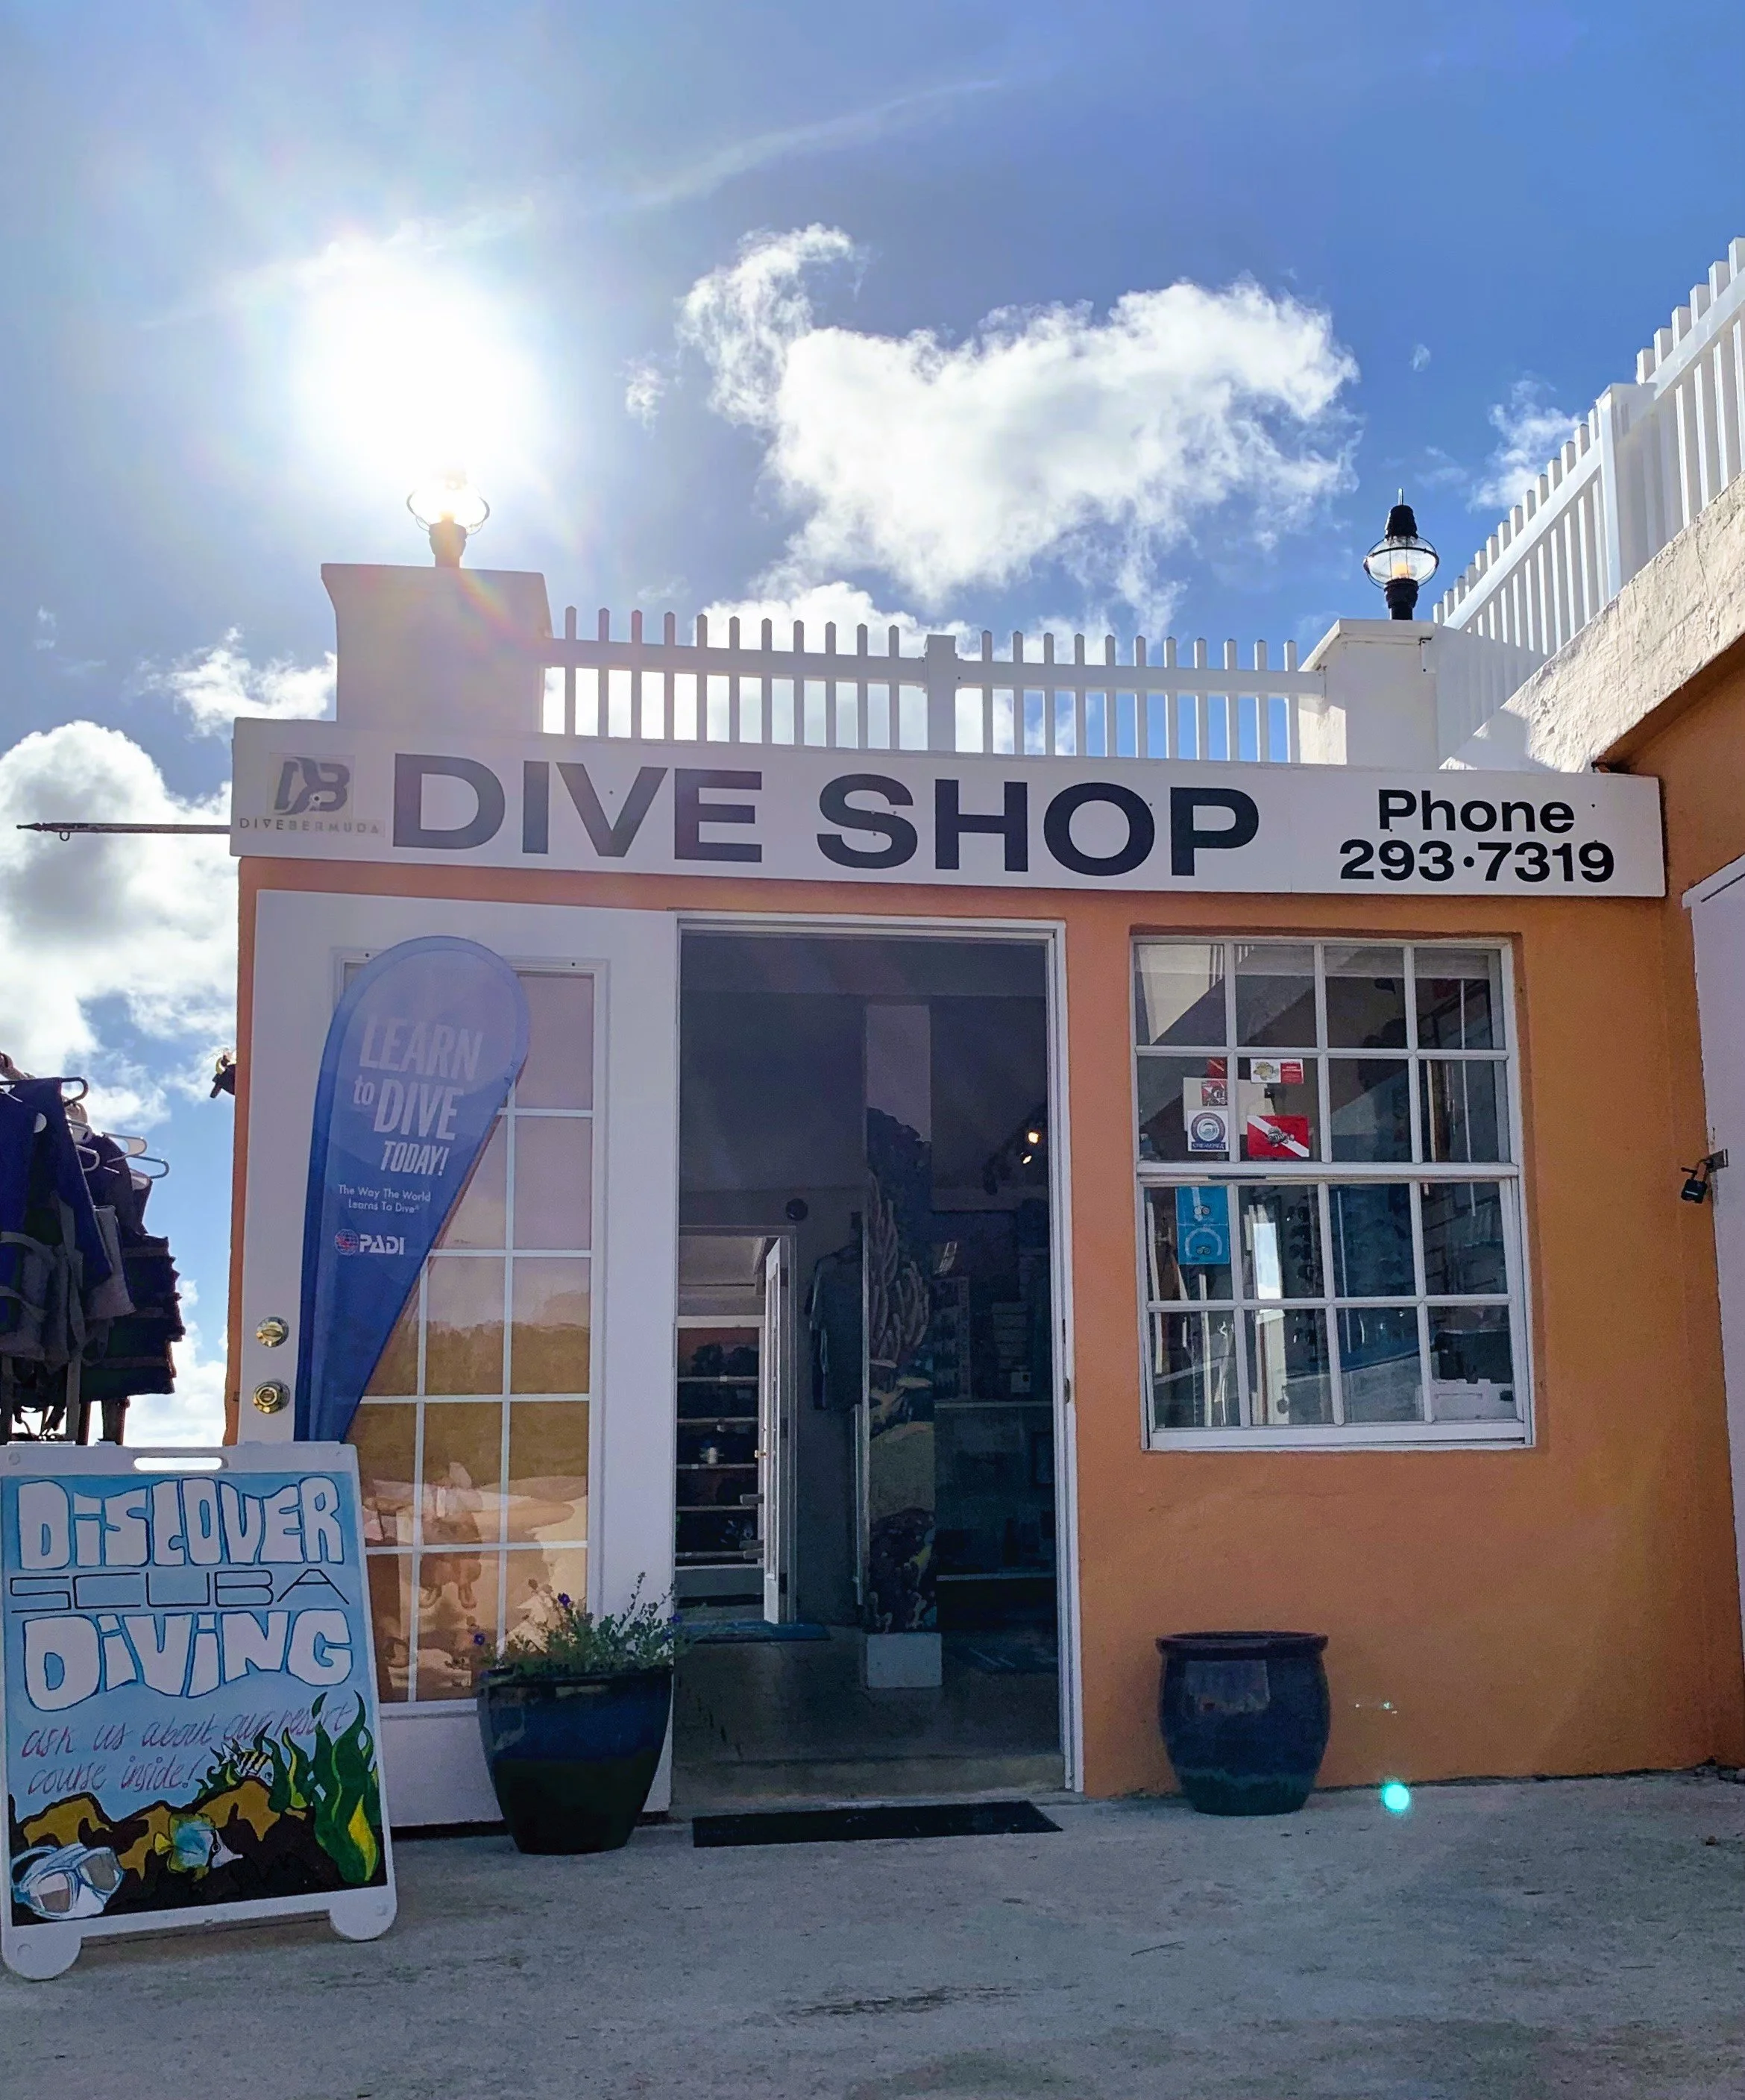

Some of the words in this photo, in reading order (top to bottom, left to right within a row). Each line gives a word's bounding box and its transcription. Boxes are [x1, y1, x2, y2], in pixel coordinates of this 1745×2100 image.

[239, 817, 379, 834] DIVEBERMUDA
[393, 752, 762, 863] DIVE
[817, 773, 1260, 876] SHOP
[1378, 789, 1575, 833] Phone
[359, 1015, 485, 1081] LEARN
[353, 1075, 374, 1105] to
[374, 1078, 464, 1140] DIVE
[380, 1140, 450, 1176] TODAY!
[338, 1183, 355, 1195] The
[358, 1186, 380, 1199] Way
[383, 1188, 400, 1199] The
[402, 1190, 431, 1202] World
[348, 1198, 379, 1210] Learns
[381, 1201, 393, 1211] To
[359, 1234, 405, 1255] PADI
[10, 1568, 350, 1614] SCUBA
[22, 1725, 75, 1758] ask
[92, 1722, 133, 1751] us
[141, 1714, 218, 1747] about
[28, 1761, 107, 1795] course
[120, 1754, 207, 1793] inside!
